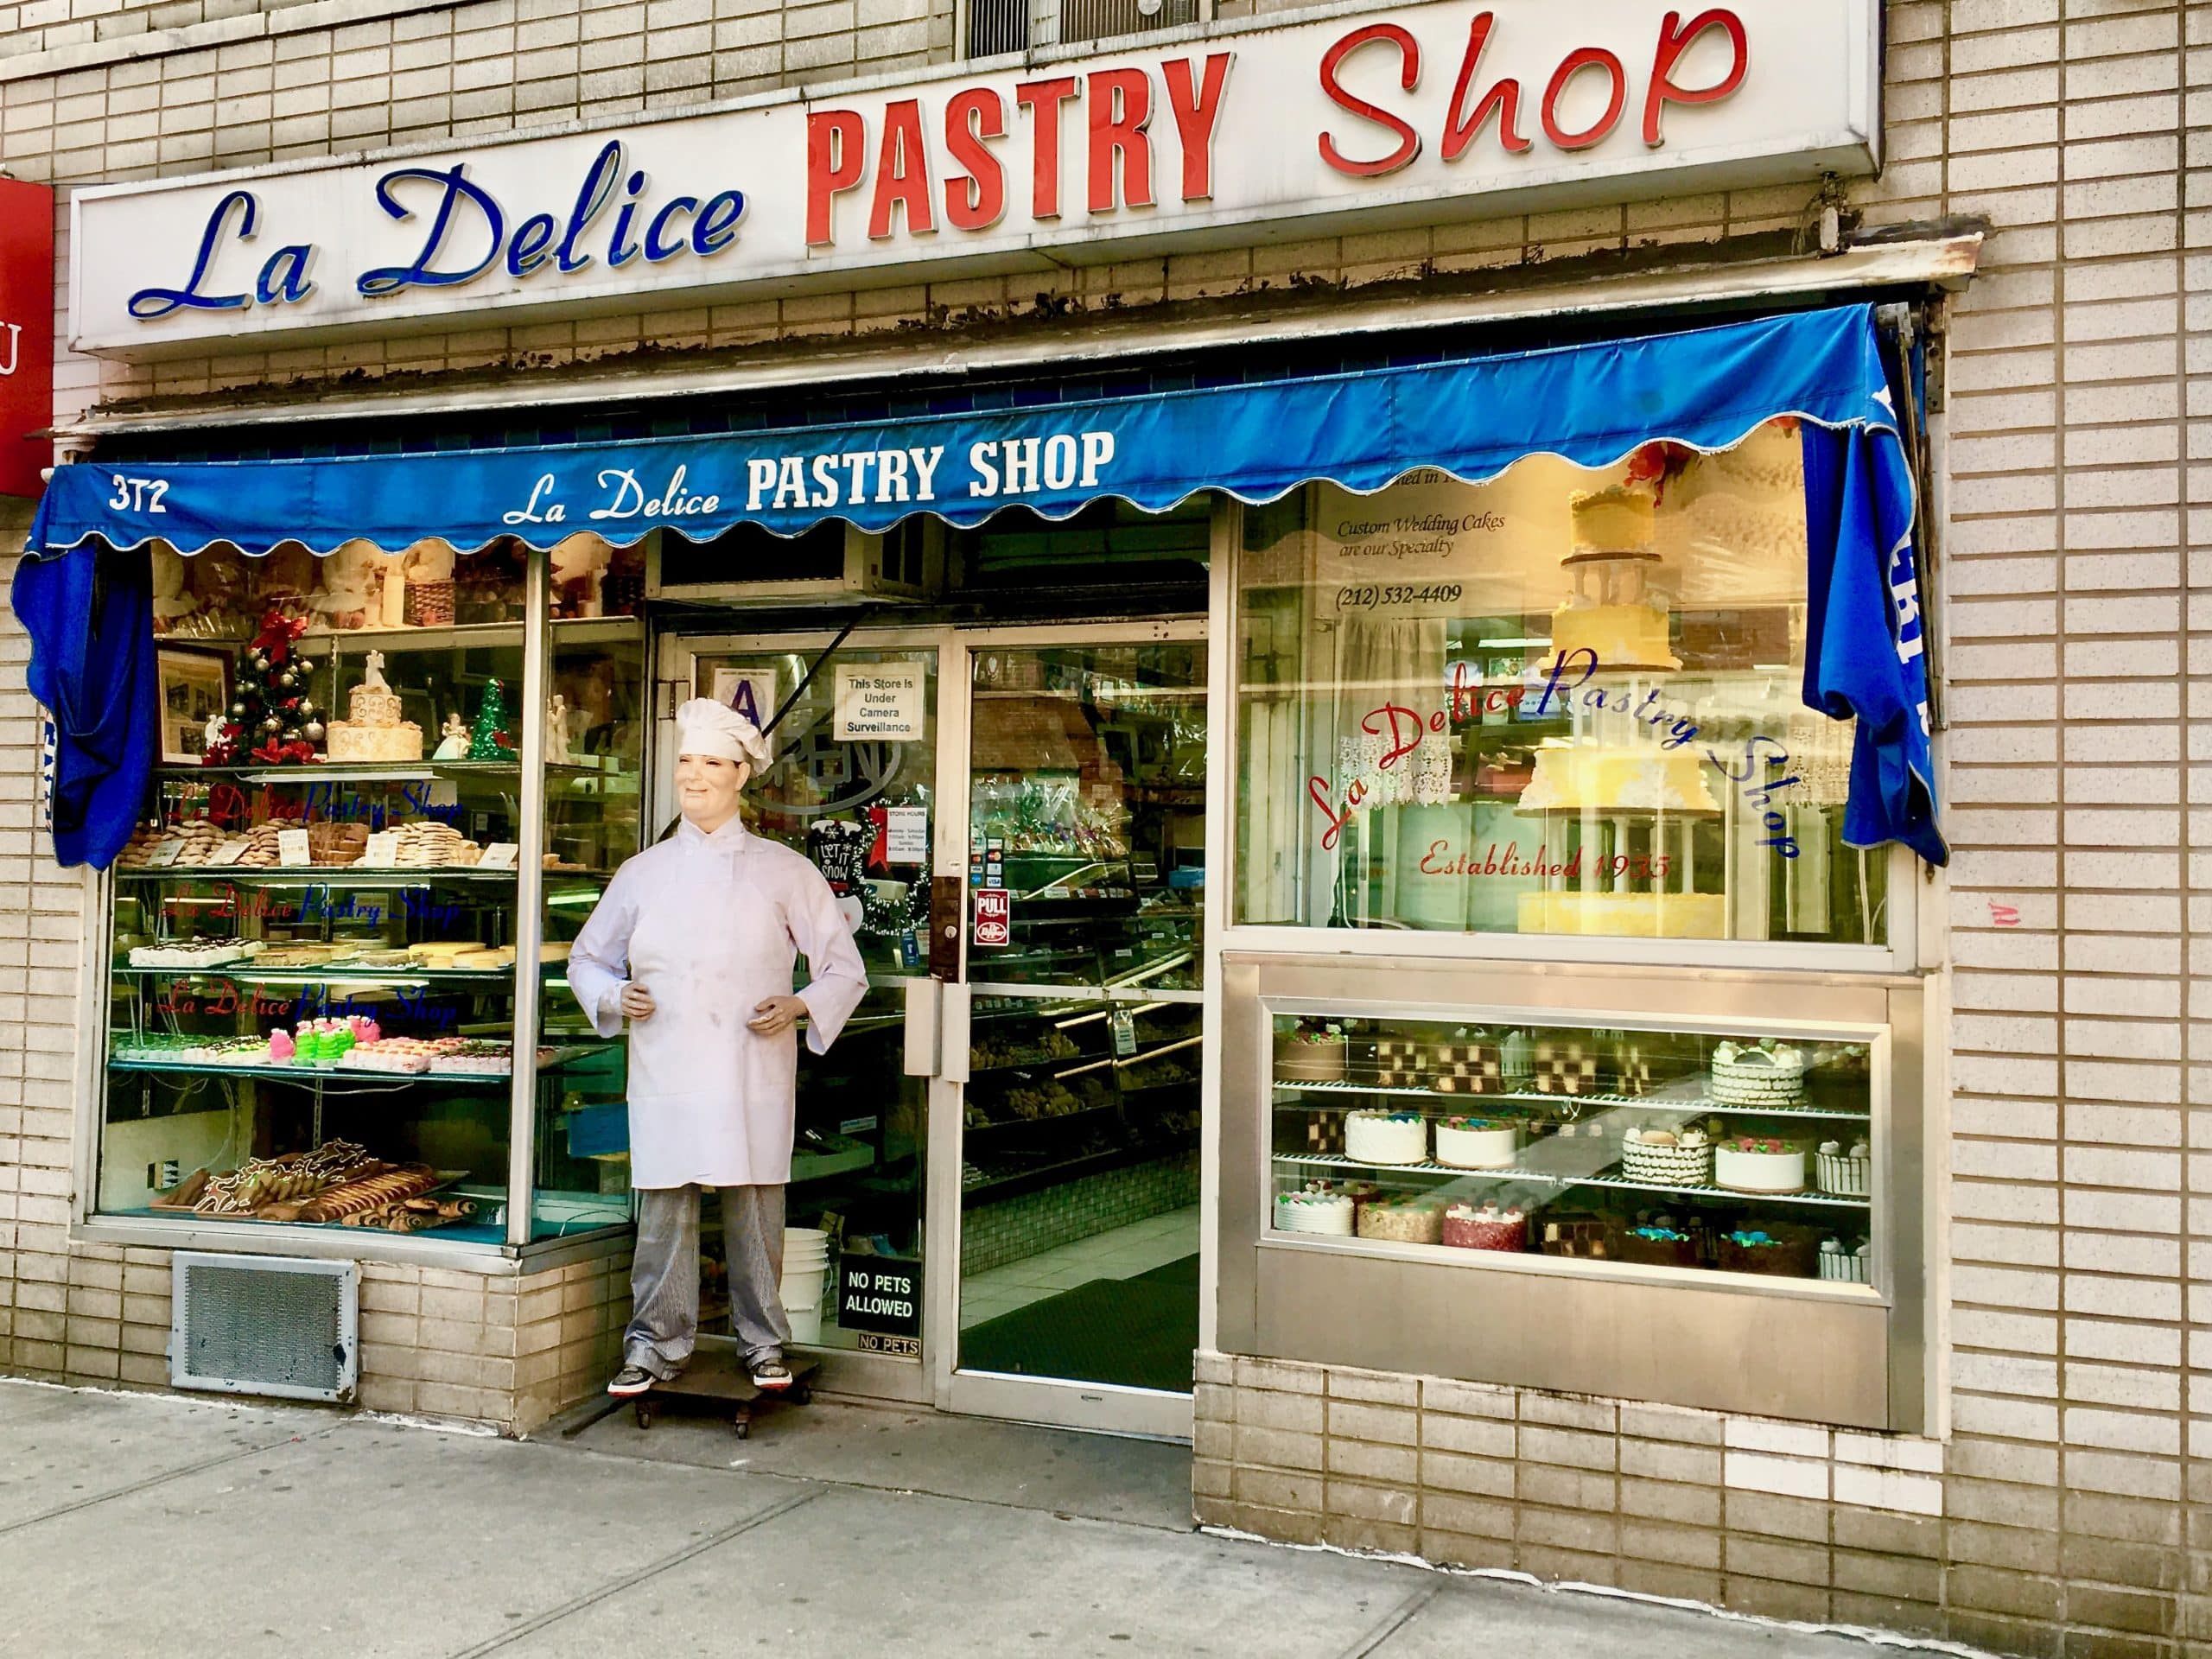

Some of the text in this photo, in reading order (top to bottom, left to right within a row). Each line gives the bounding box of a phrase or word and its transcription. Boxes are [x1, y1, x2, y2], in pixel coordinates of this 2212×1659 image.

[128, 9, 1749, 319] La Delice PASTRY Shop
[503, 473, 566, 524] La
[588, 464, 720, 520] Delice
[745, 445, 945, 512] PASTRY
[969, 430, 1116, 498] SHOP
[1338, 512, 1505, 537] Custom Wedding Cakes
[1339, 536, 1455, 559] are our Specialty
[1336, 584, 1462, 612] (212) 532-4409
[849, 678, 871, 689] This
[874, 678, 901, 690] Store
[864, 693, 897, 702] Under
[859, 707, 899, 717] Camera
[847, 721, 912, 732] Surveillance
[1360, 662, 1526, 770] Delice
[1535, 647, 1699, 751] Pastry
[1706, 735, 1801, 860] Shop
[391, 779, 465, 825] Shop
[1420, 839, 1584, 877] Established
[387, 881, 461, 930] Shop
[977, 897, 1007, 913] PULL
[155, 978, 196, 1014] La
[203, 978, 290, 1015] Delice
[385, 984, 458, 1030] Shop
[849, 1271, 912, 1294] NO PETS
[845, 1294, 913, 1318] ALLOWED
[860, 1336, 918, 1355] NO PETS
